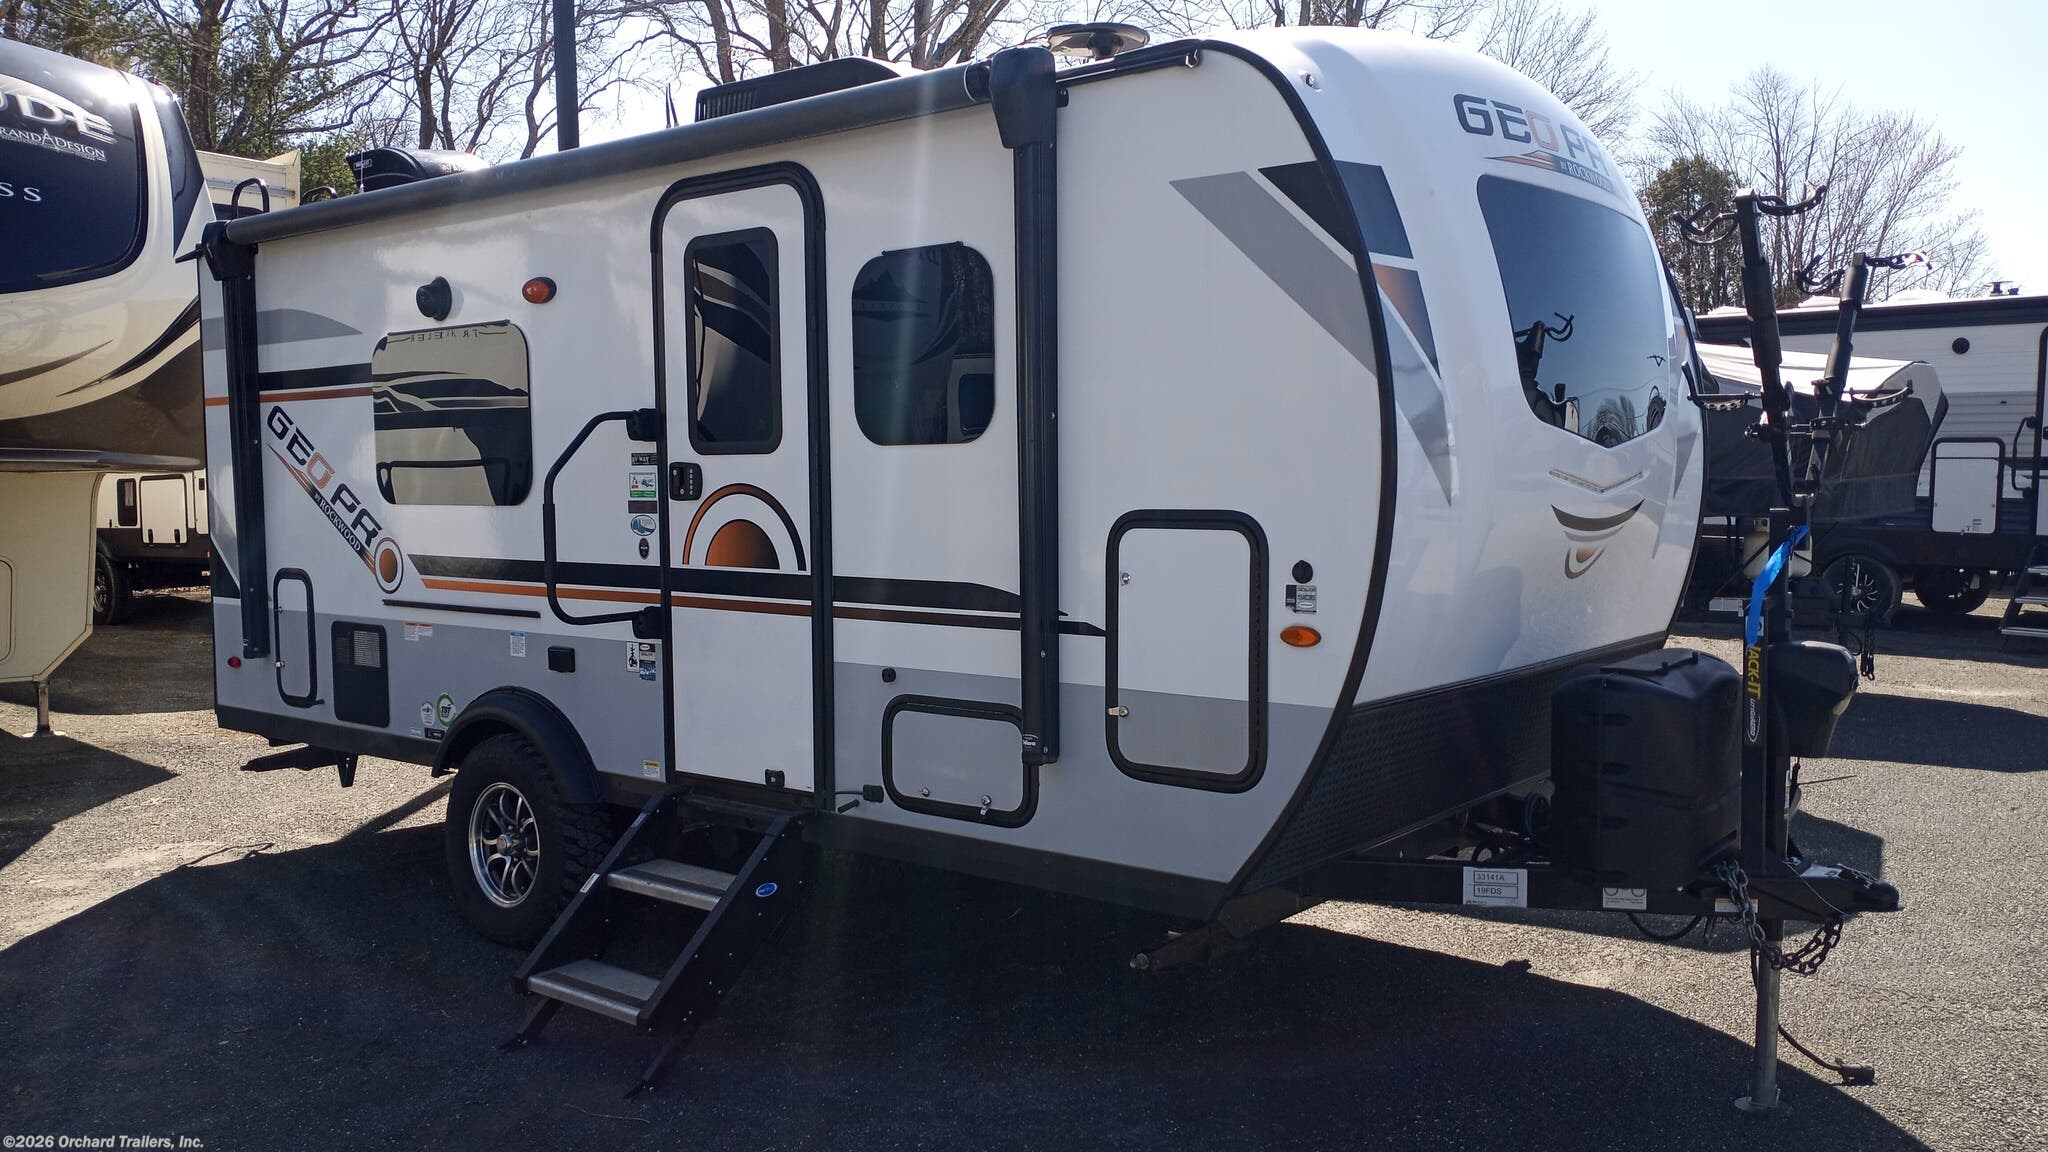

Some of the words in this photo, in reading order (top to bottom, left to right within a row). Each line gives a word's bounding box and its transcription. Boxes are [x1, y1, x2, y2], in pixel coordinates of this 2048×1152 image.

[0, 89, 118, 145] DE
[1453, 94, 1560, 152] GEO
[55, 138, 106, 159] DESIGN
[267, 405, 335, 490] GEO
[320, 500, 361, 550] ROCKWOOD
[1476, 873, 1504, 881] 33141A
[1476, 887, 1502, 895] 19FDS
